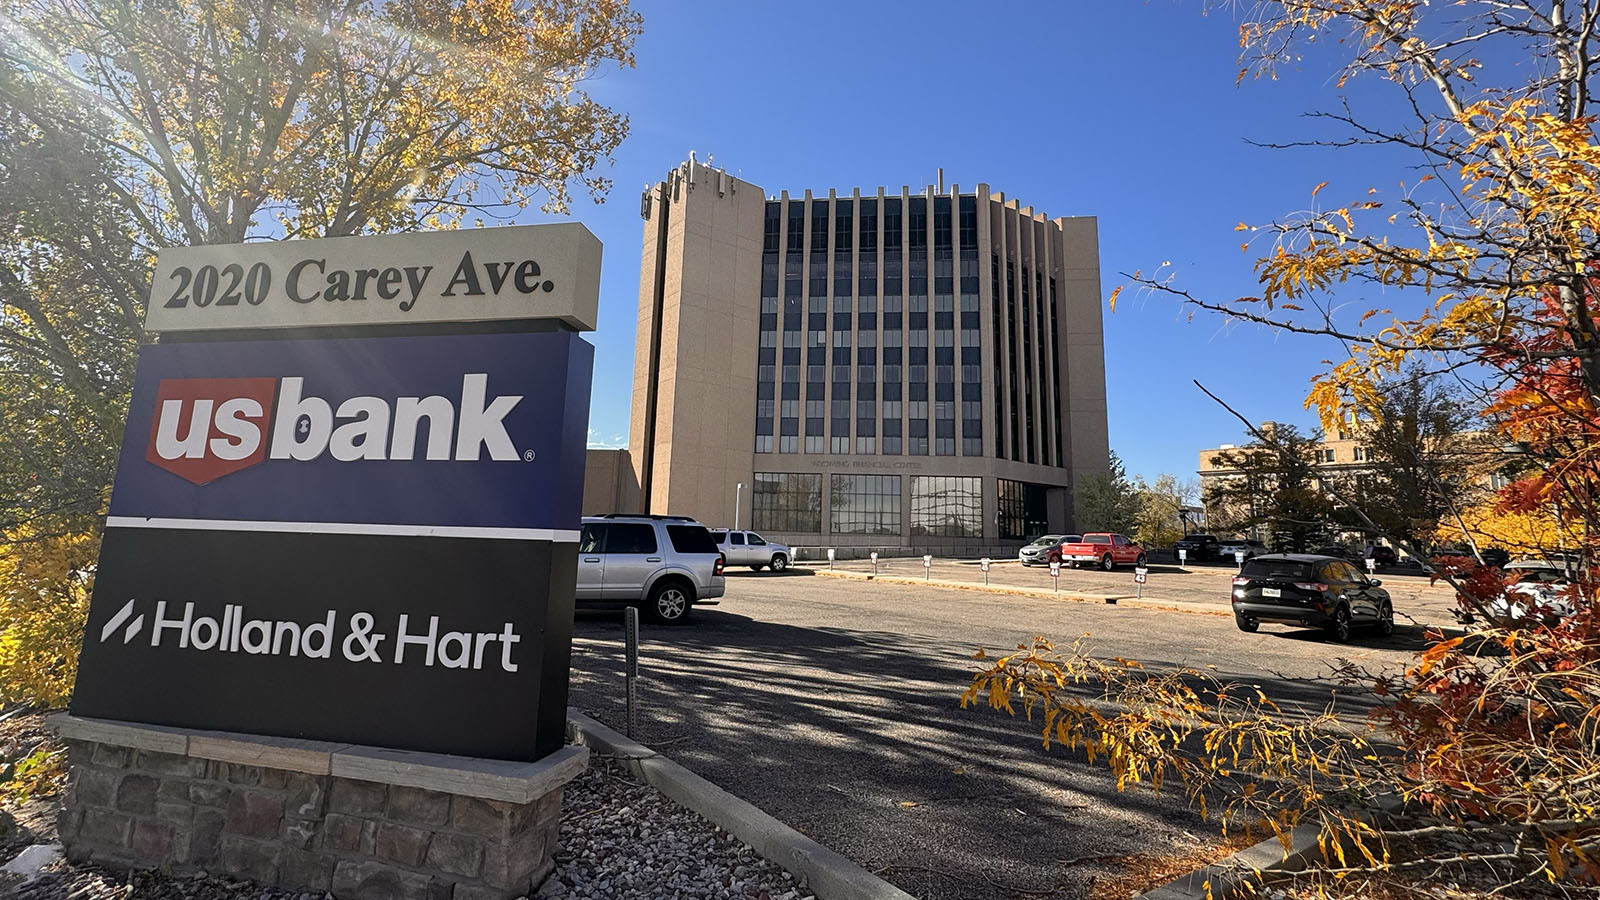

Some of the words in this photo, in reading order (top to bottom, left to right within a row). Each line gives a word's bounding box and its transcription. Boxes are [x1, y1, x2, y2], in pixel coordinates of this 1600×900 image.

[163, 262, 272, 309] 2020
[285, 258, 434, 312] Carey
[440, 250, 555, 297] Ave.
[1135, 574, 1145, 583] 43
[150, 600, 336, 659] Holland
[343, 611, 386, 663] &
[394, 613, 521, 672] Hart
